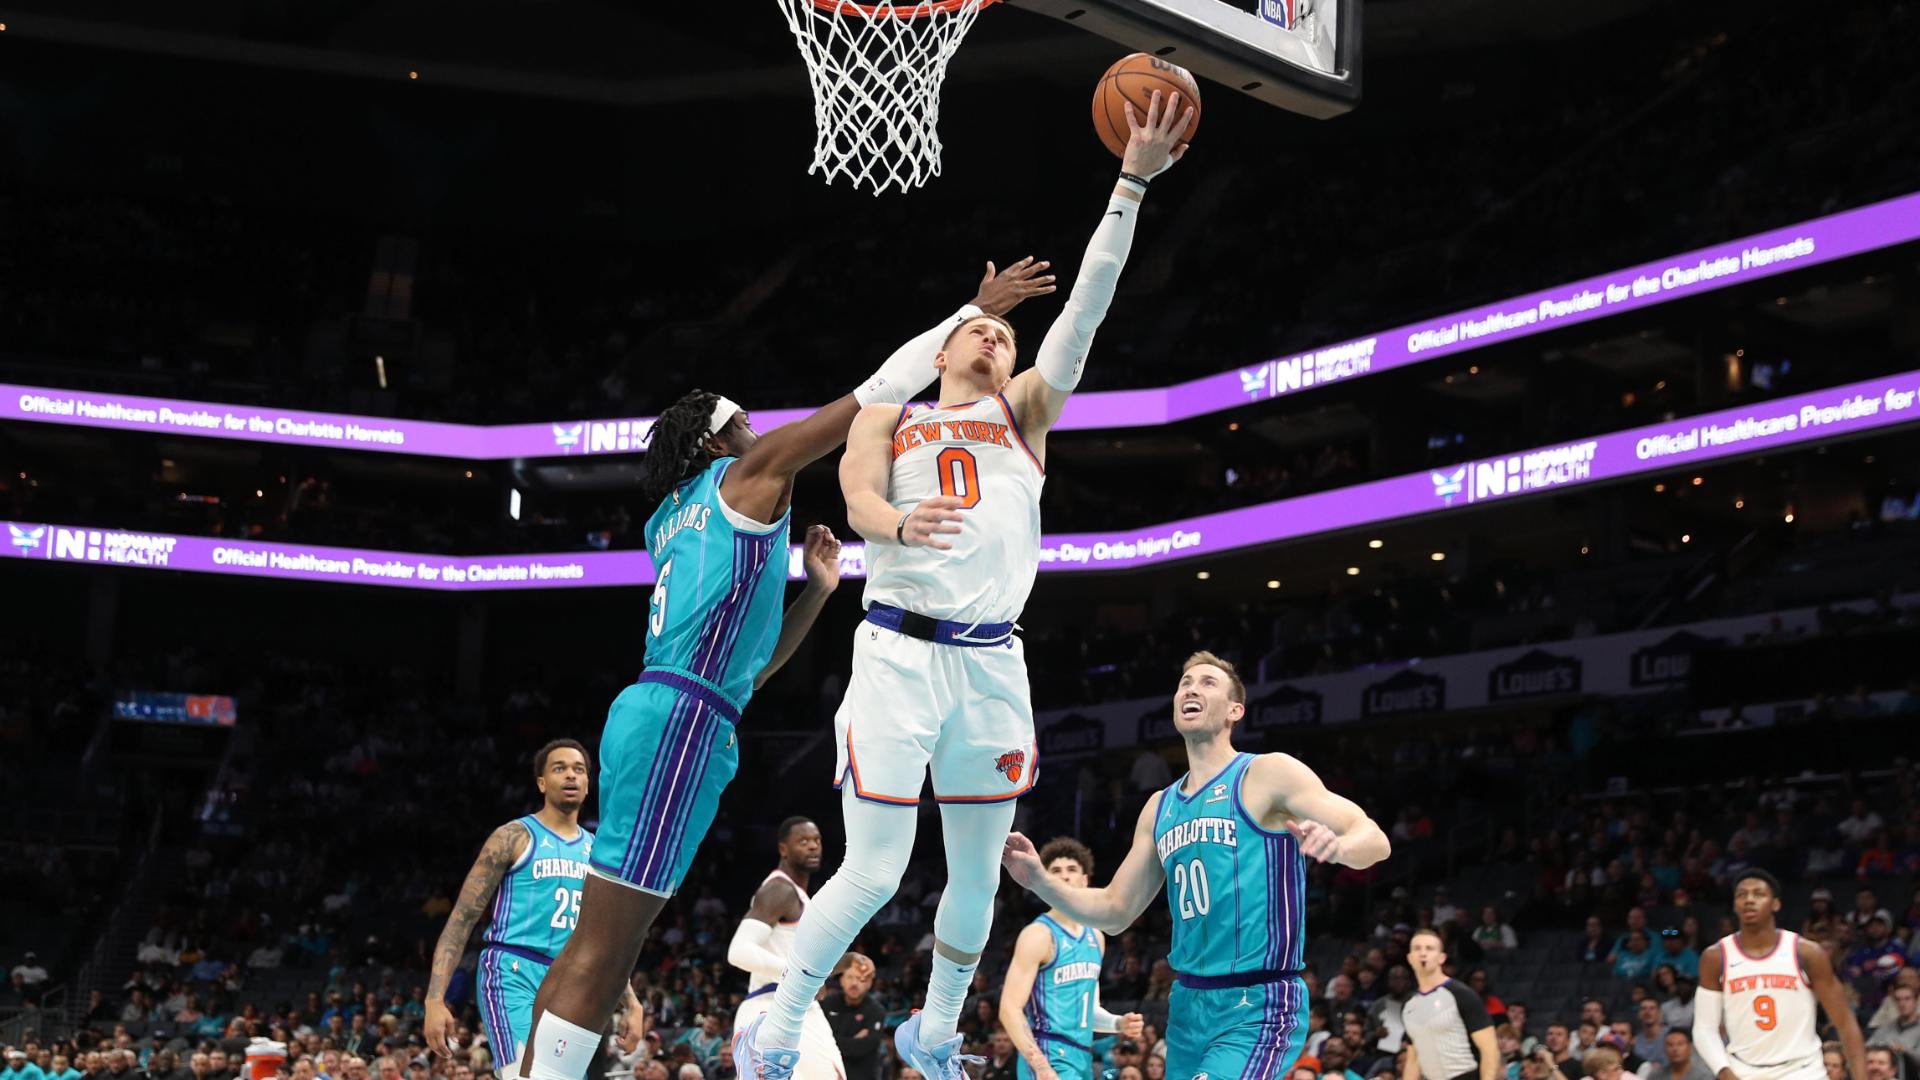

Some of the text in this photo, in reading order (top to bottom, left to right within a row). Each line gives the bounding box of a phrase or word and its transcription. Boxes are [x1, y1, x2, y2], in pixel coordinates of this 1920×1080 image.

[1264, 0, 1282, 22] NBA
[1407, 237, 1815, 353] Official Healthcare Provider for the Charlotte Hornets
[1315, 338, 1377, 368] NOVANT
[1315, 355, 1371, 384] HEALTH
[19, 395, 405, 445] Official Healthcare Provider for the Charlotte Hornets
[1635, 428, 1699, 460] Official
[1700, 413, 1798, 448] Healthcare
[1799, 397, 1881, 428] Provider
[1884, 388, 1915, 412] for
[892, 420, 1013, 461] NEW YORK
[1523, 441, 1598, 473] NOVANT
[936, 446, 982, 510] 0
[1523, 460, 1590, 490] HEALTH
[103, 532, 177, 553] NOVANT
[654, 503, 712, 559] ILLIAMS
[1092, 542, 1137, 561] Ortho
[1137, 537, 1171, 558] Injury
[1171, 530, 1201, 549] Care
[103, 547, 169, 566] HEALTH
[212, 547, 585, 582] Official Healthcare Provider for the Charlotte Hornets
[651, 558, 673, 638] 5
[1496, 666, 1574, 696] LOWE'S
[1174, 858, 1211, 920] 20
[550, 886, 583, 931] 25
[1728, 974, 1799, 995] NEW YORK
[1080, 991, 1091, 1028] 1
[1753, 994, 1777, 1032] 9
